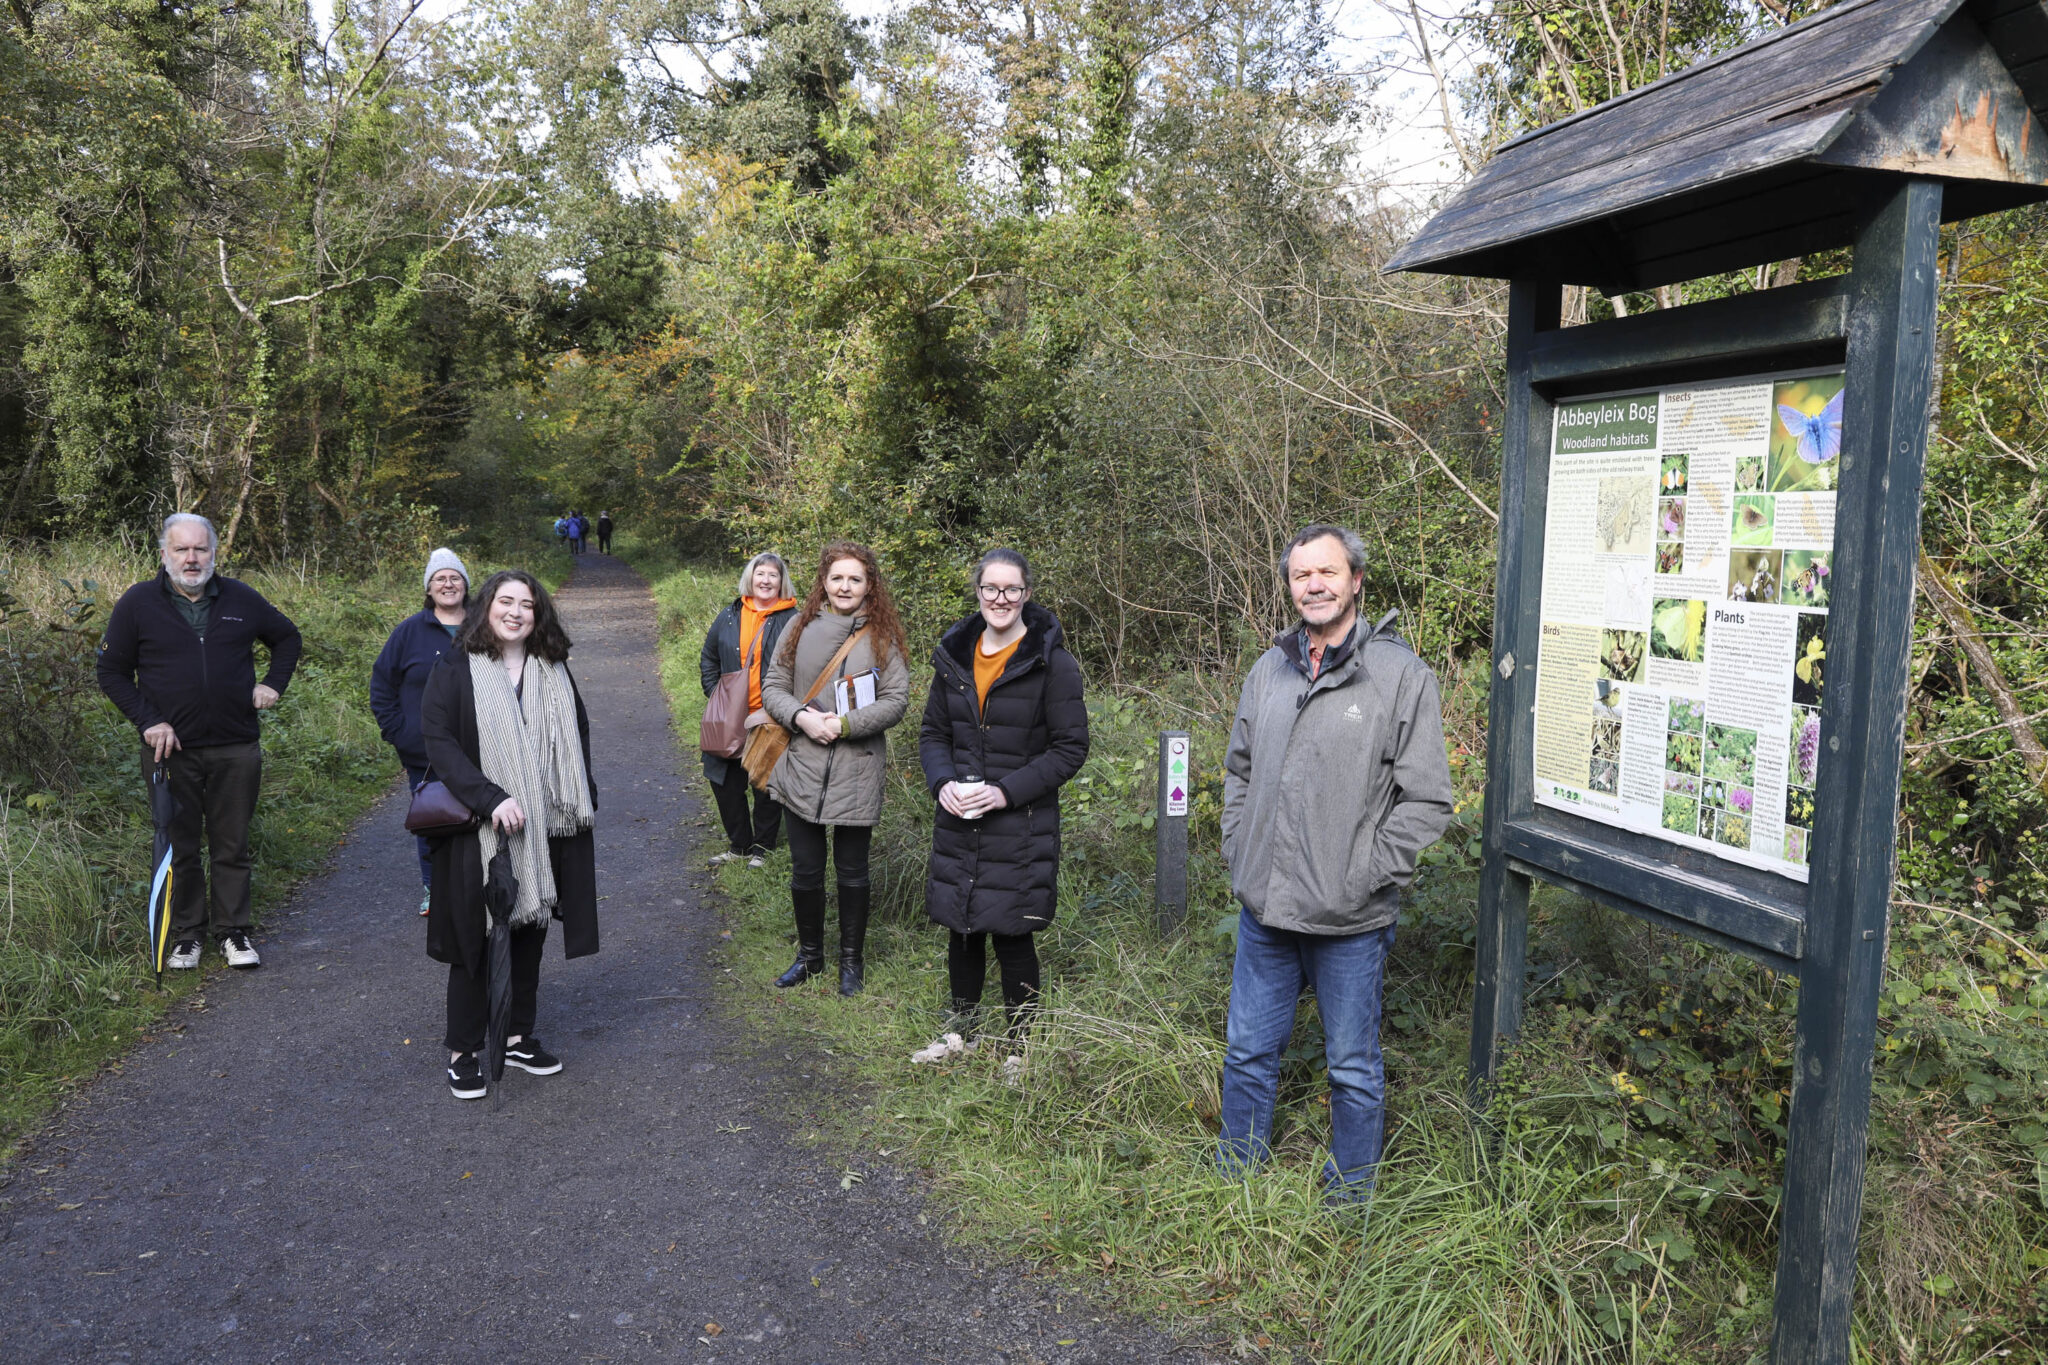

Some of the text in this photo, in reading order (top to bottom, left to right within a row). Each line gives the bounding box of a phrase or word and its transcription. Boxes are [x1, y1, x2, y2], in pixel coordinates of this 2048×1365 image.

[1664, 392, 1692, 403] Insects
[1559, 402, 1657, 428] Abbeyleix Bog
[1562, 432, 1649, 449] Woodland habitats
[1714, 609, 1745, 624] Plants
[1543, 624, 1560, 636] Birds
